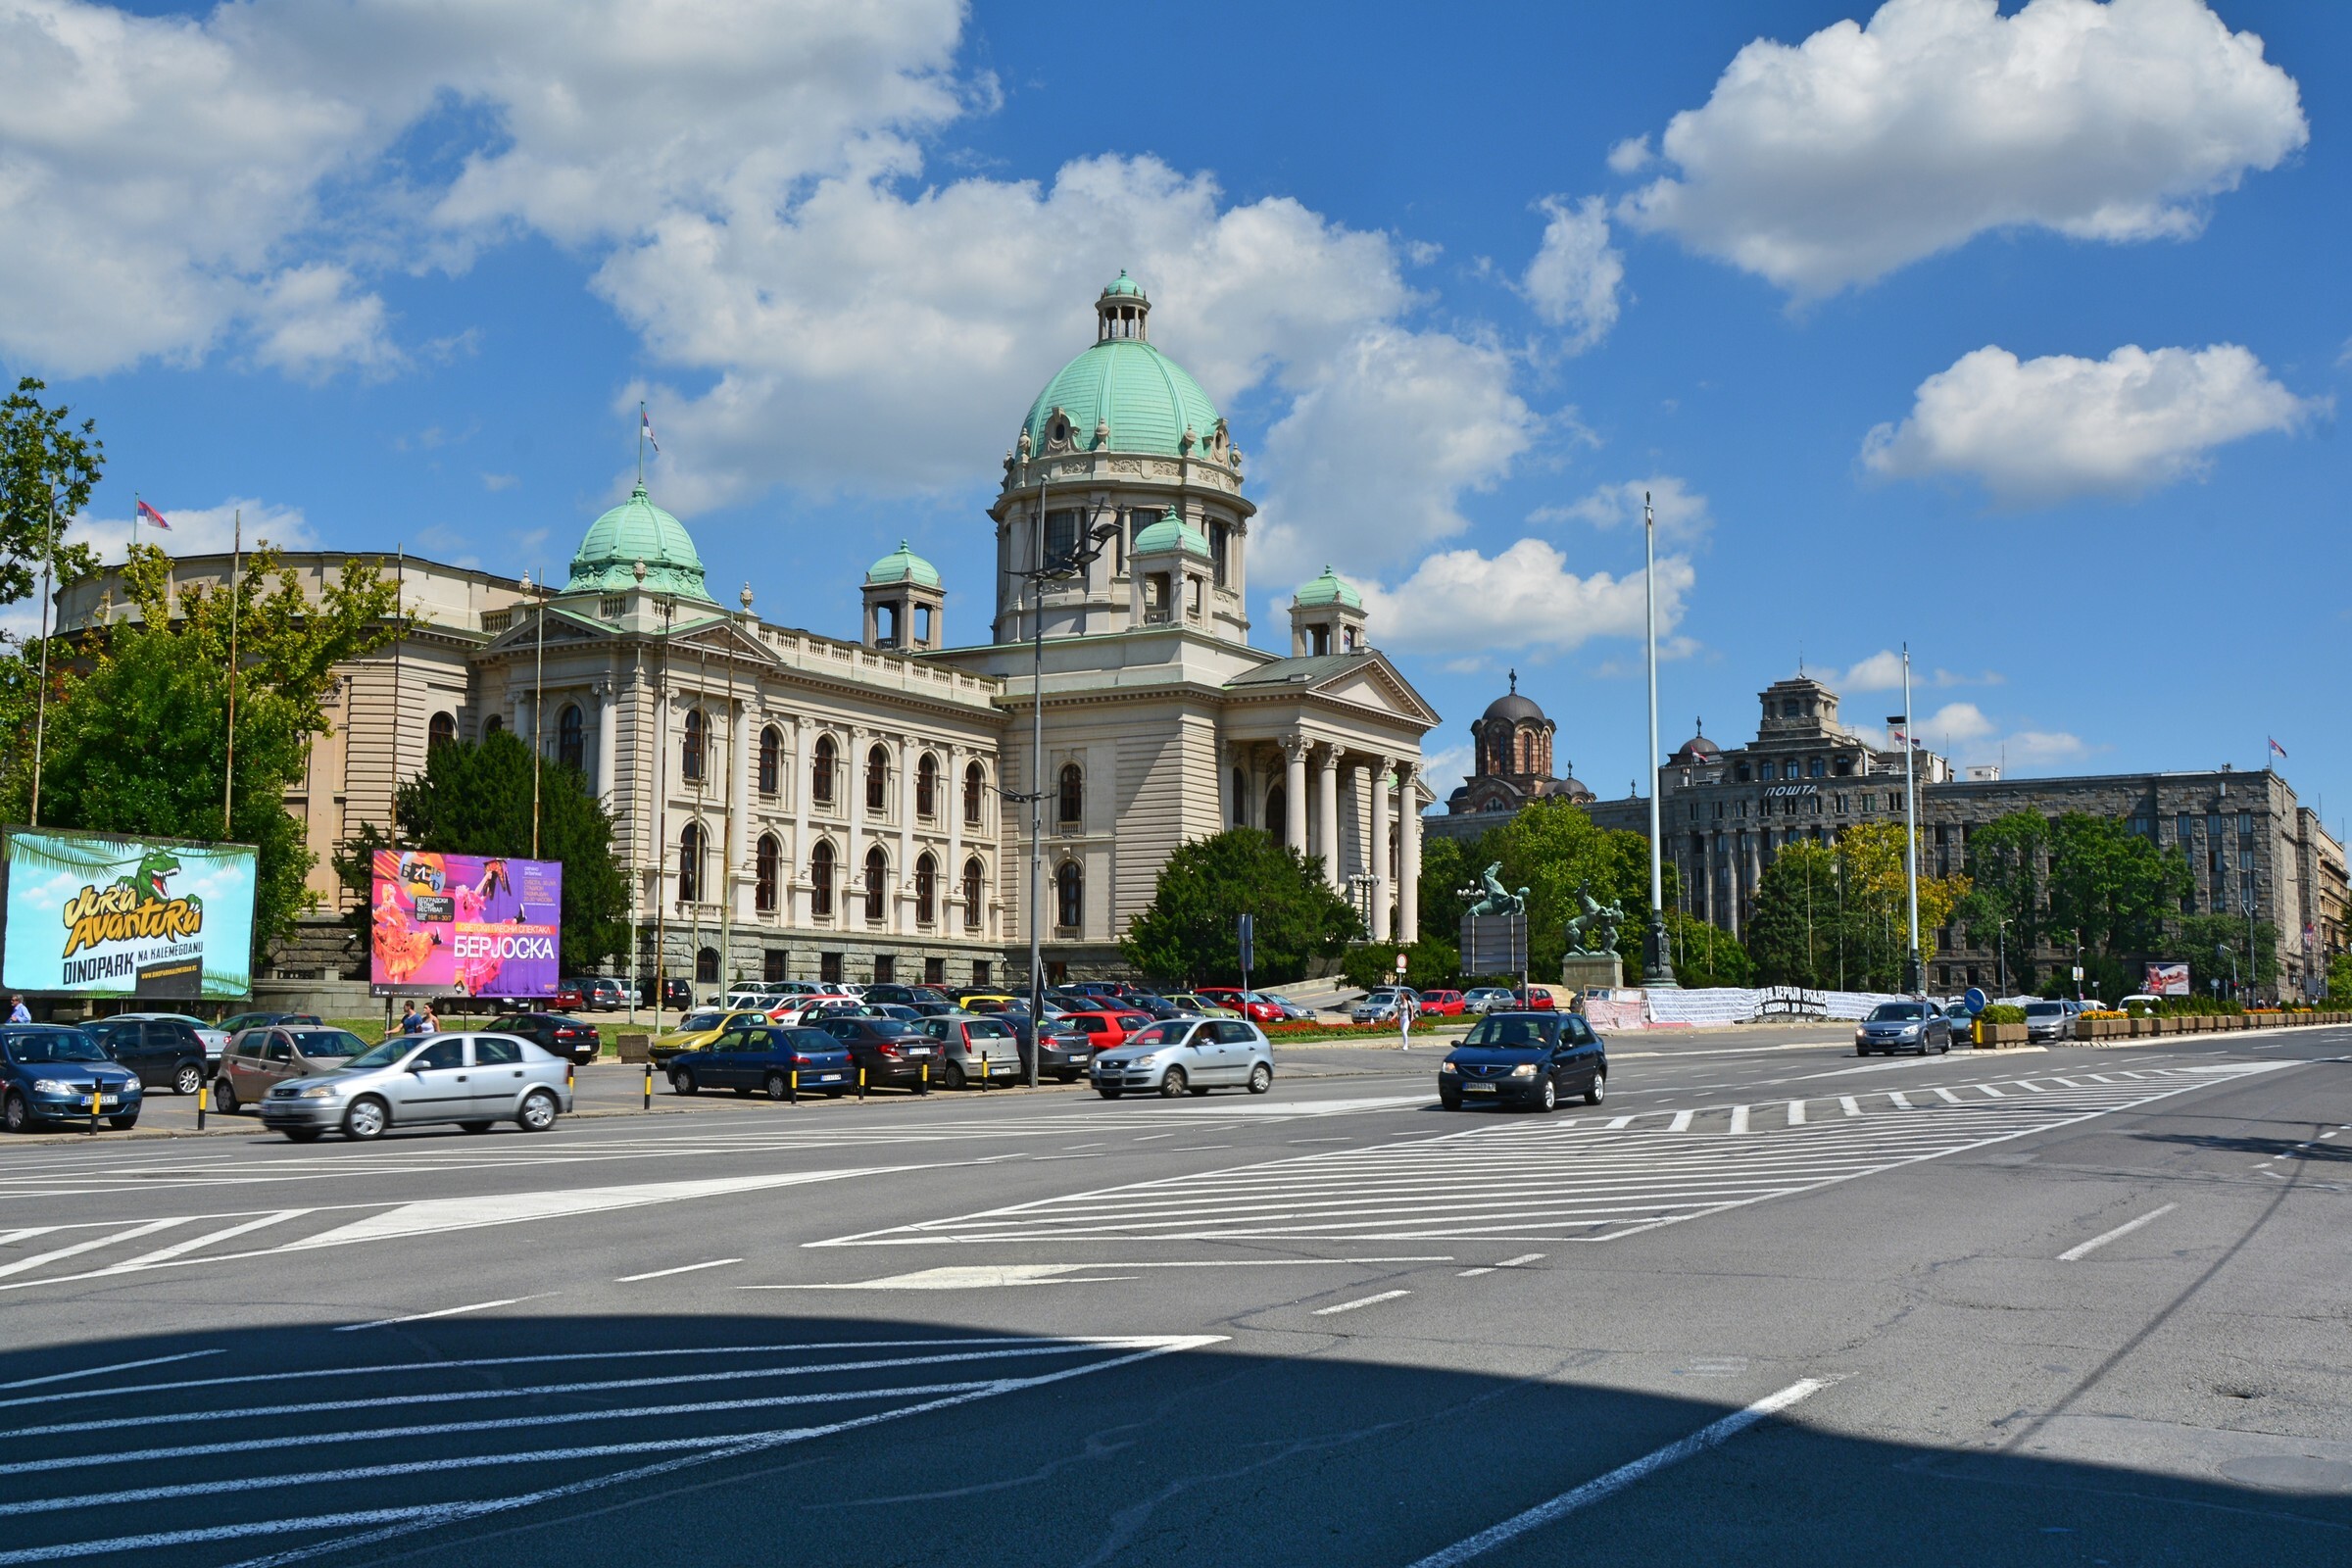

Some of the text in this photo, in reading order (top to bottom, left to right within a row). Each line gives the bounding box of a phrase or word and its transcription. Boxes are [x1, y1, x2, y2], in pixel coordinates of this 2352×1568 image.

[1764, 785, 1818, 797] ПОШТА
[454, 935, 555, 958] БЕРЈОСКА
[63, 941, 204, 985] DINOPARK NA KALEMEGDANU
